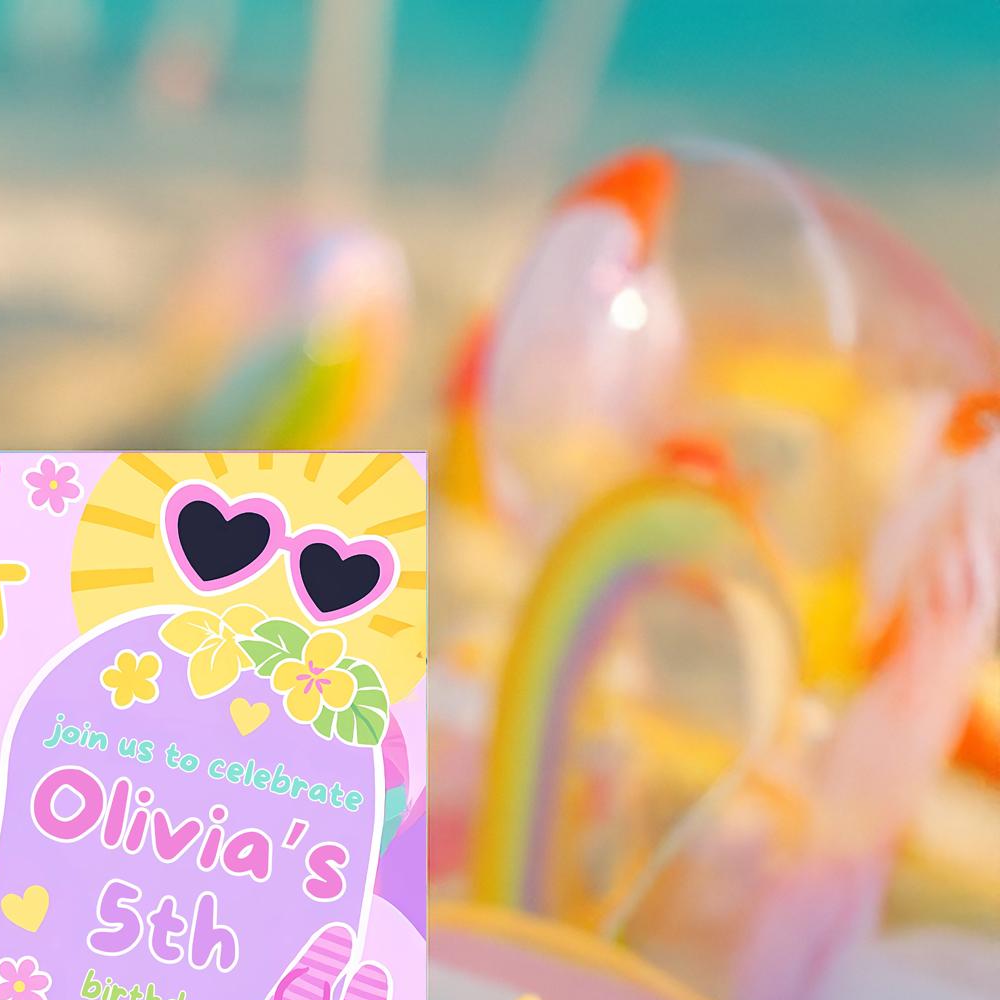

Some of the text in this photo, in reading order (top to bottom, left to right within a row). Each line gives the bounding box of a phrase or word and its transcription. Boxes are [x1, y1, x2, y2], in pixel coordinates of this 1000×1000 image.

[43, 713, 364, 812] join us to celebrate
[31, 765, 350, 902] Olivia's
[87, 878, 239, 972] 5th
